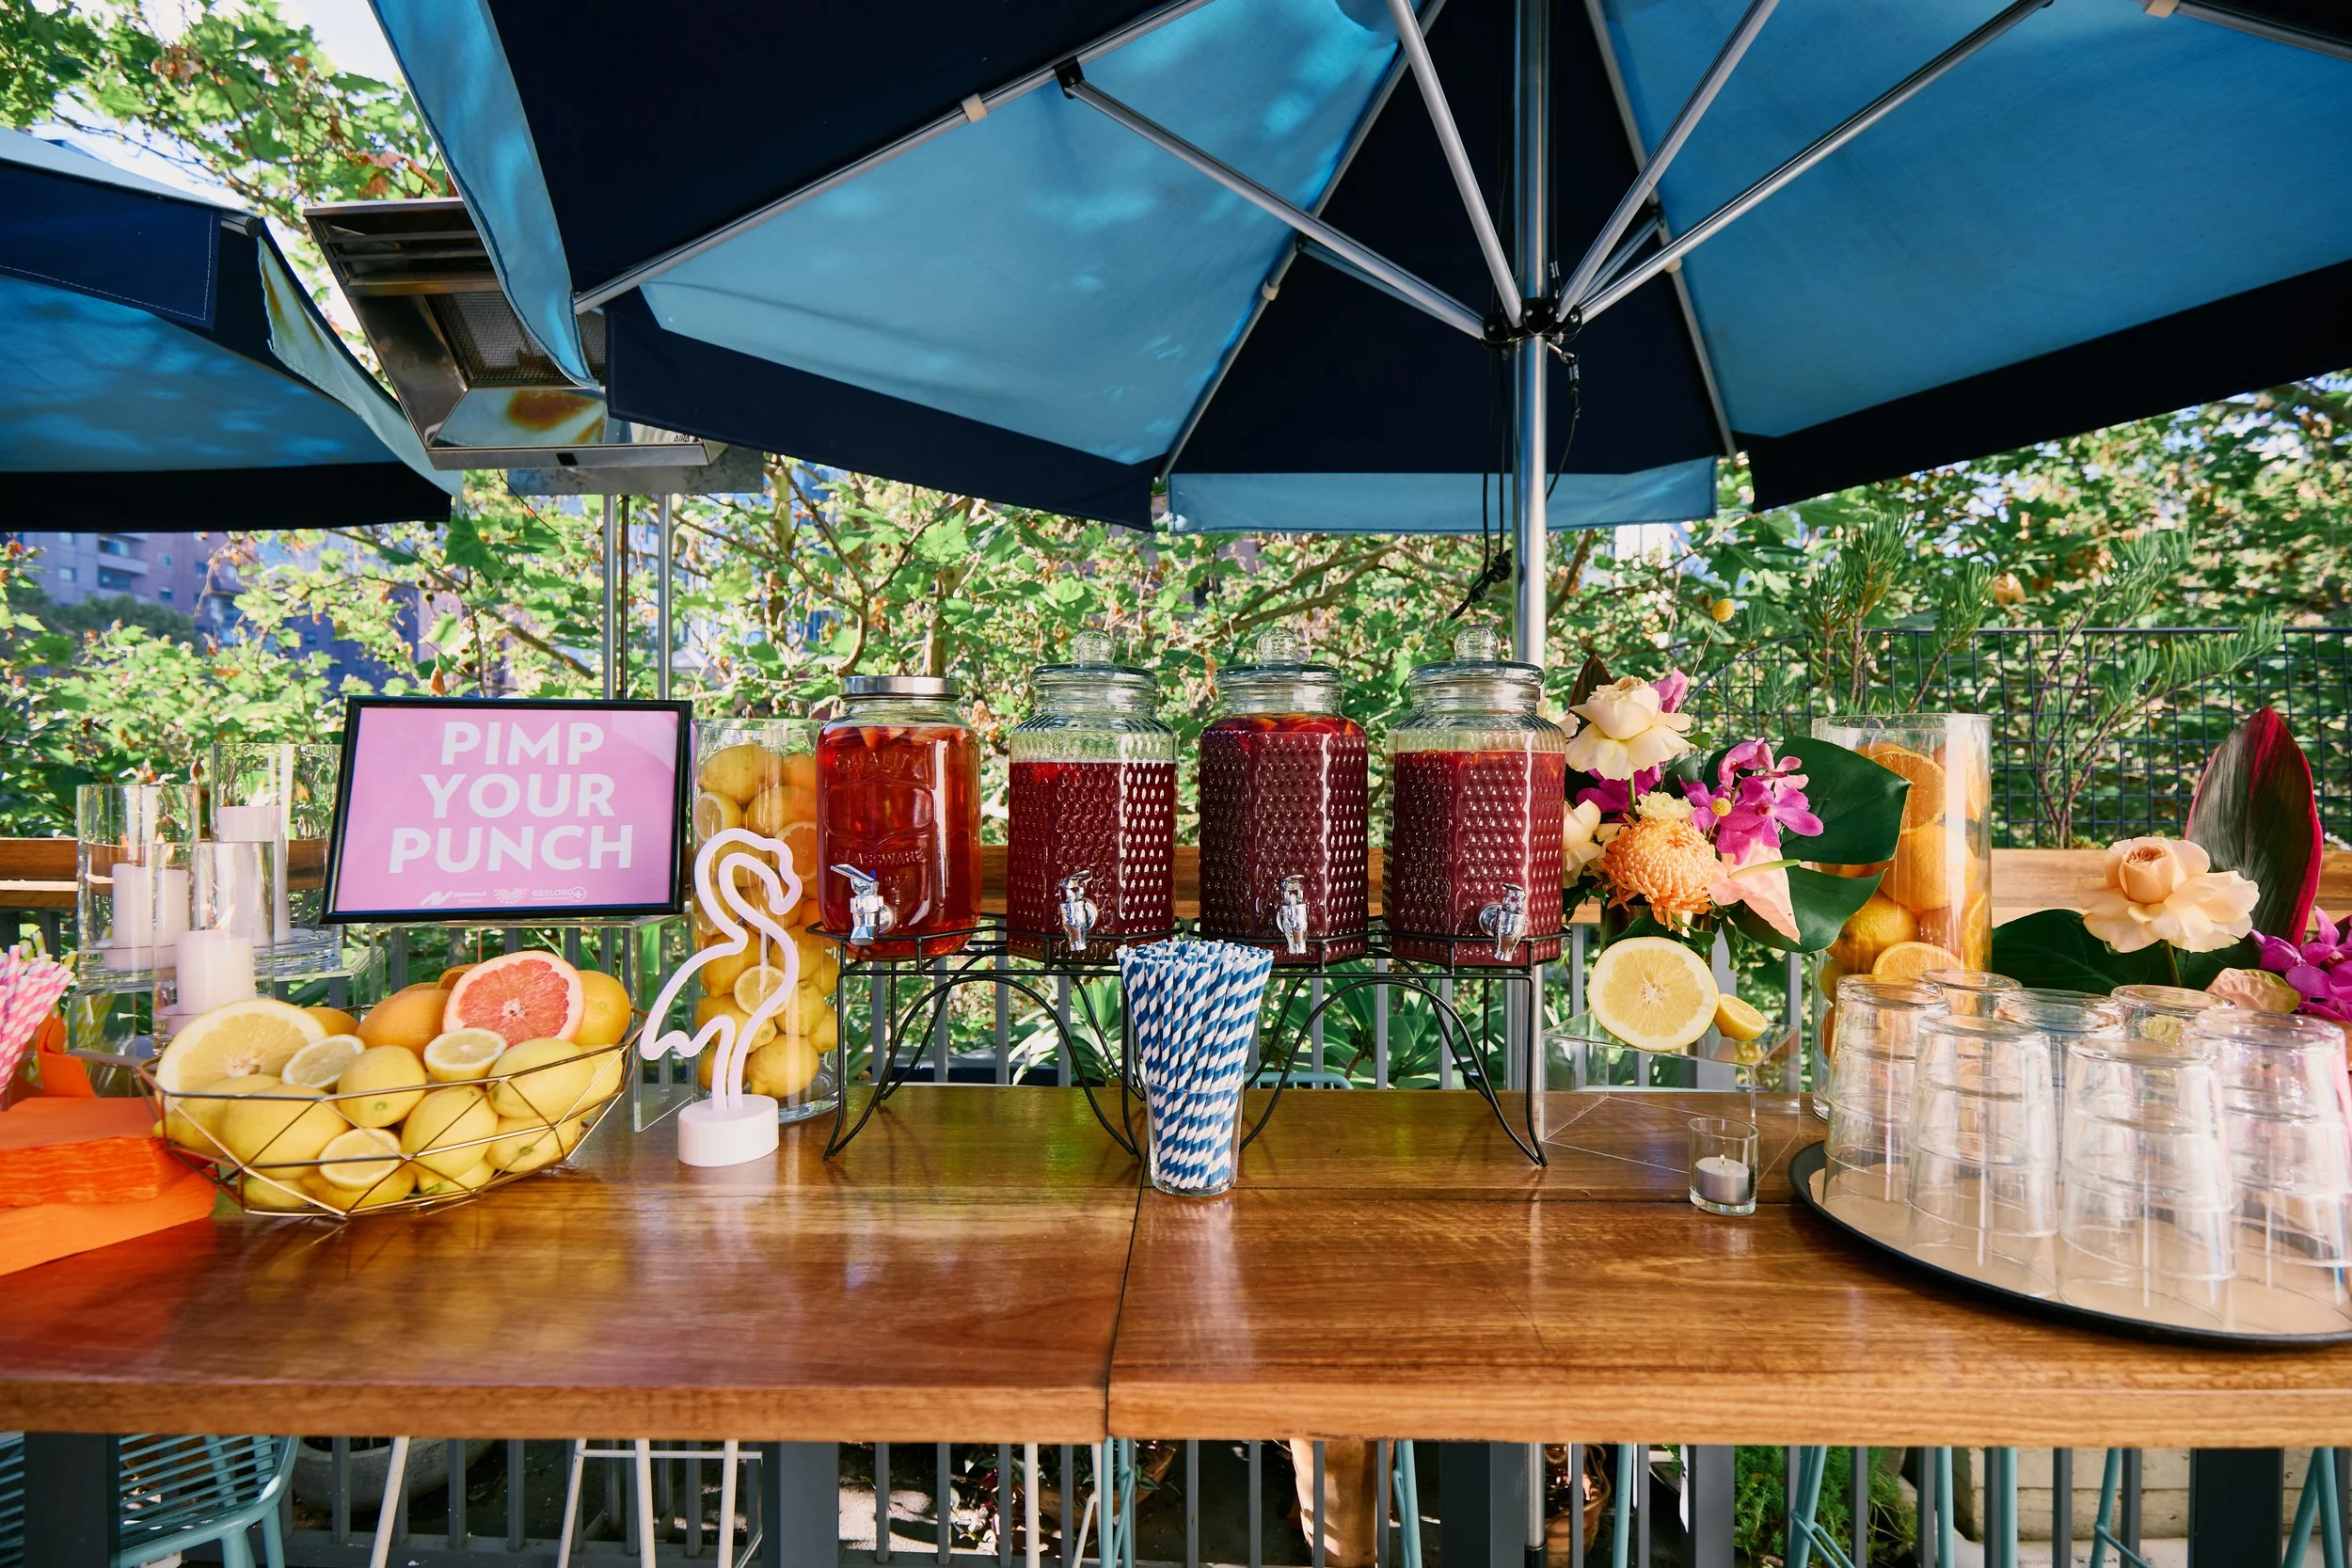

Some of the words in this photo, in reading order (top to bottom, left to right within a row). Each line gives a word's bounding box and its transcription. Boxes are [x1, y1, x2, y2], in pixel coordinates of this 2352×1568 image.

[440, 721, 604, 766] PIMP
[420, 773, 615, 818] YOUR
[389, 824, 633, 874] PUNCH
